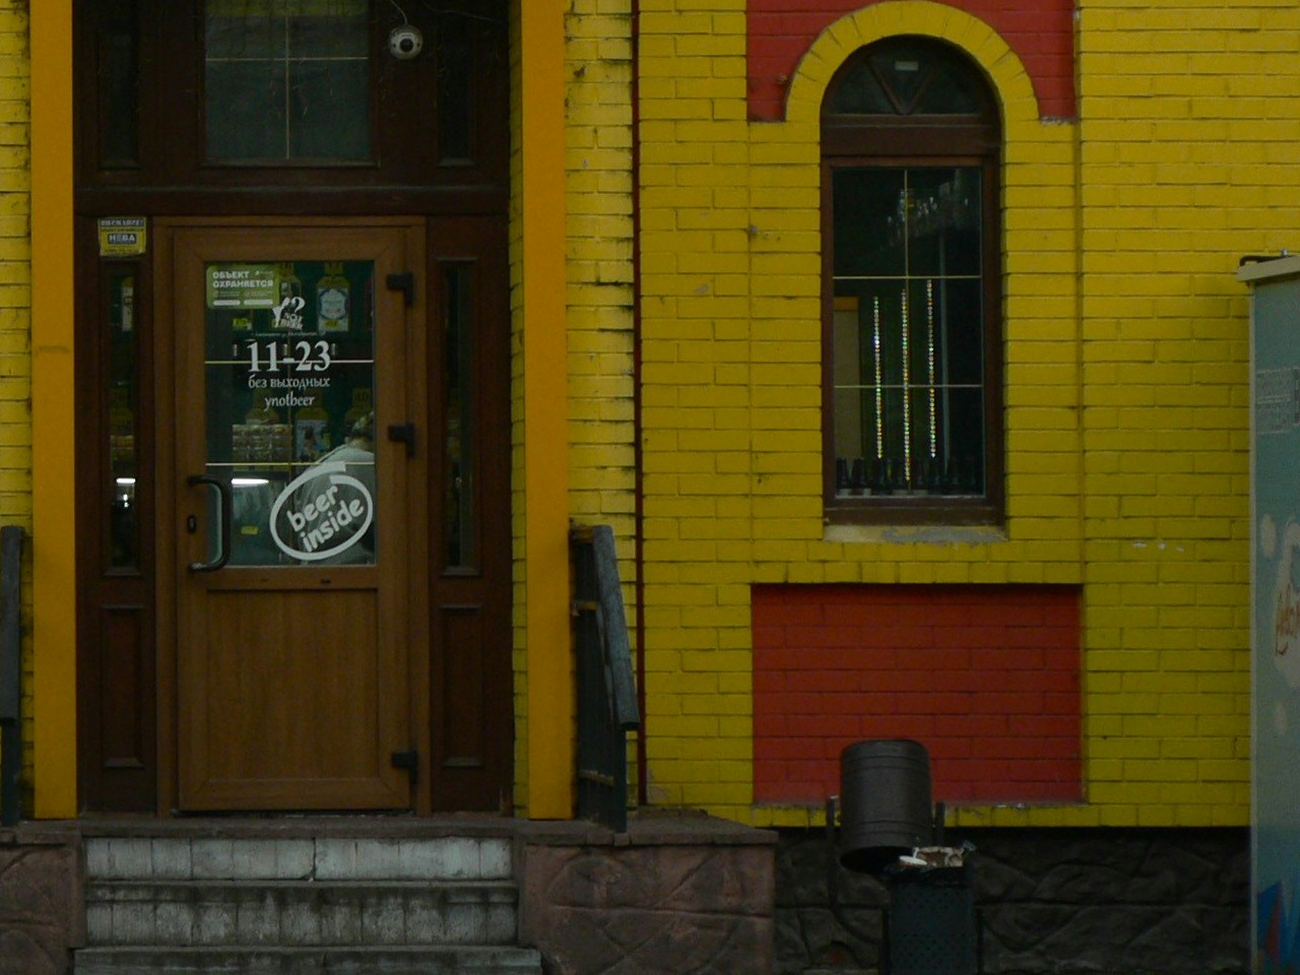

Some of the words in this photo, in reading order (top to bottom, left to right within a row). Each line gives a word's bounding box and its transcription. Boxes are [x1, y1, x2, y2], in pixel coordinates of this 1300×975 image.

[212, 270, 250, 280] ОБЪЕКТ
[212, 280, 274, 288] ОХРАНЯЕТСЯ
[246, 340, 331, 372] 11-23
[248, 374, 267, 388] без
[270, 378, 331, 391] выходных
[263, 391, 316, 412] ynotbeer
[286, 485, 338, 532] beer
[300, 498, 365, 553] inside
